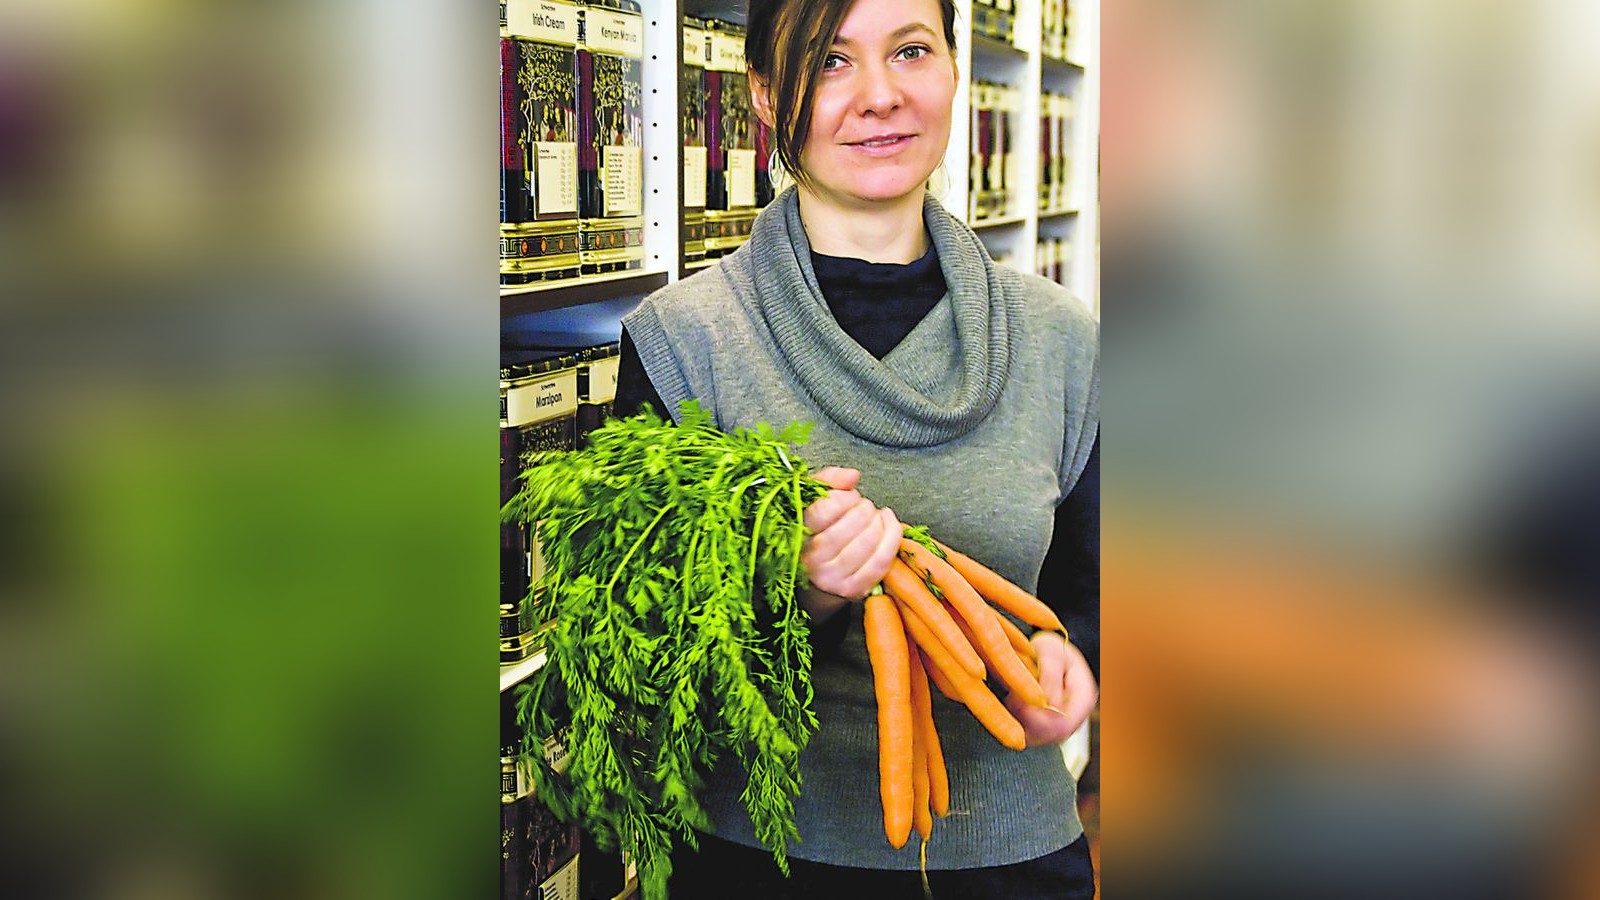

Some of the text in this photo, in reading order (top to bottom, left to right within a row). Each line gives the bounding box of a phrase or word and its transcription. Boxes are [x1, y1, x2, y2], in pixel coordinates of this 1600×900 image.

[532, 13, 565, 30] Irish Cream
[601, 27, 619, 40] Kenyan
[536, 393, 562, 408] Marzipan
